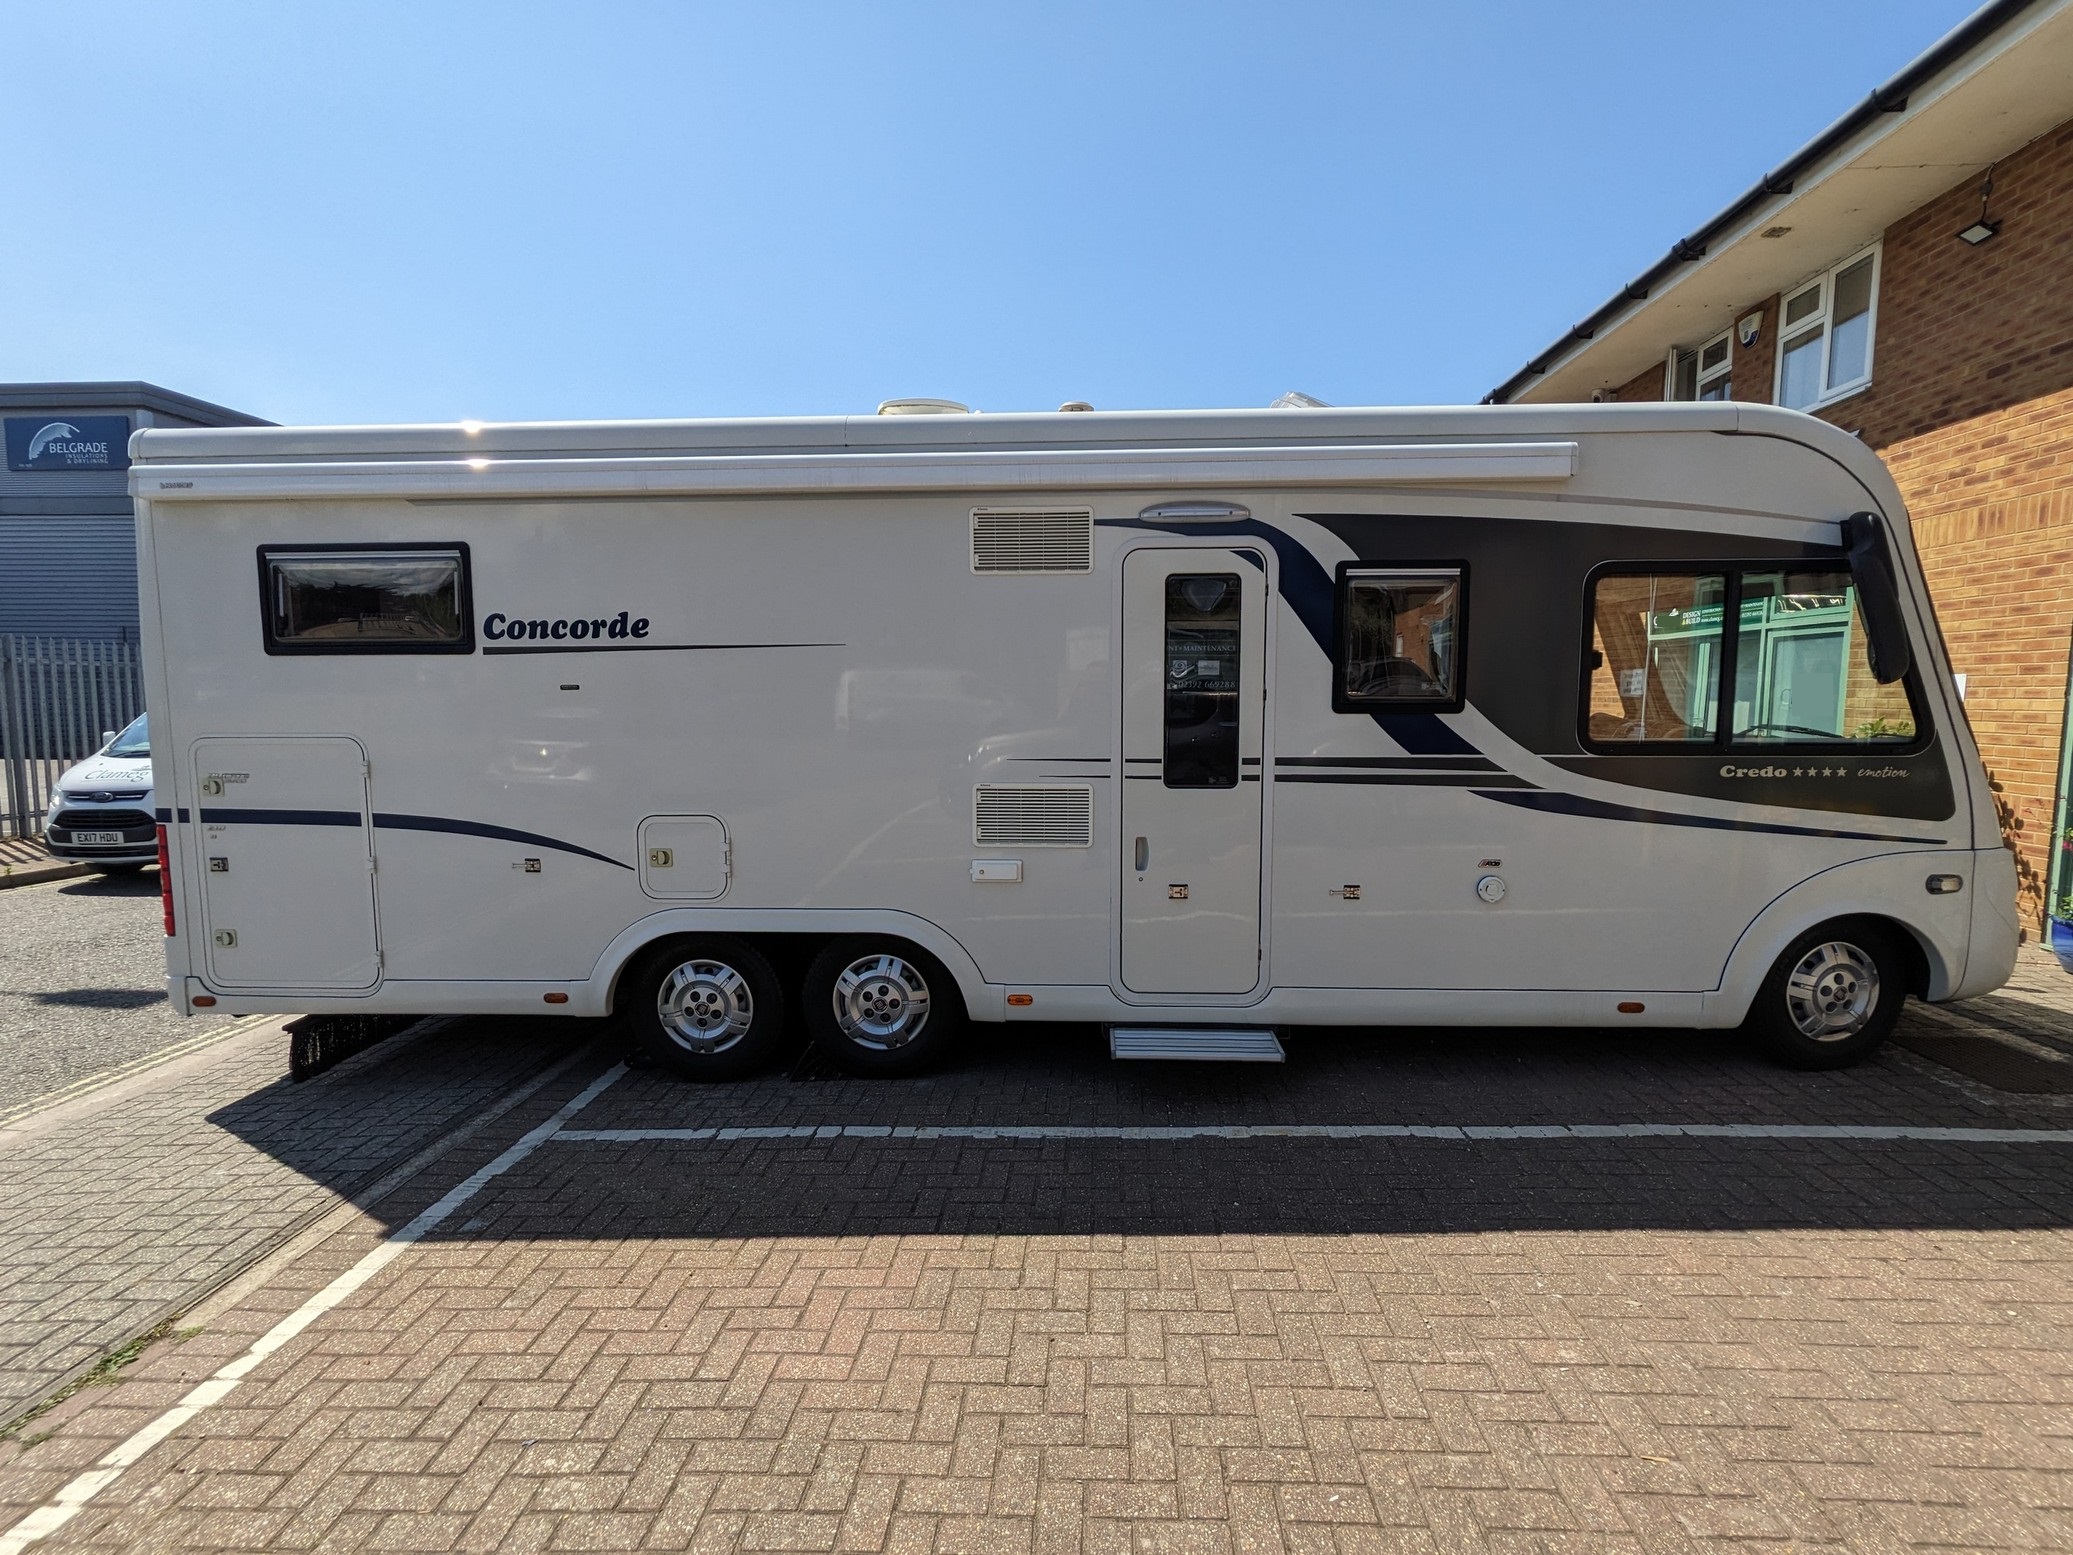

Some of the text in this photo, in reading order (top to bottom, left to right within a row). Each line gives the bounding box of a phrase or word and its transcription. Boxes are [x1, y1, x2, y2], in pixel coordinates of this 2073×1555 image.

[49, 442, 108, 453] BELGRADE
[483, 611, 650, 640] Concorde
[1204, 680, 1236, 688] 669288
[1719, 765, 1911, 778] Credo emotion
[77, 832, 118, 842] EX17 HDU
